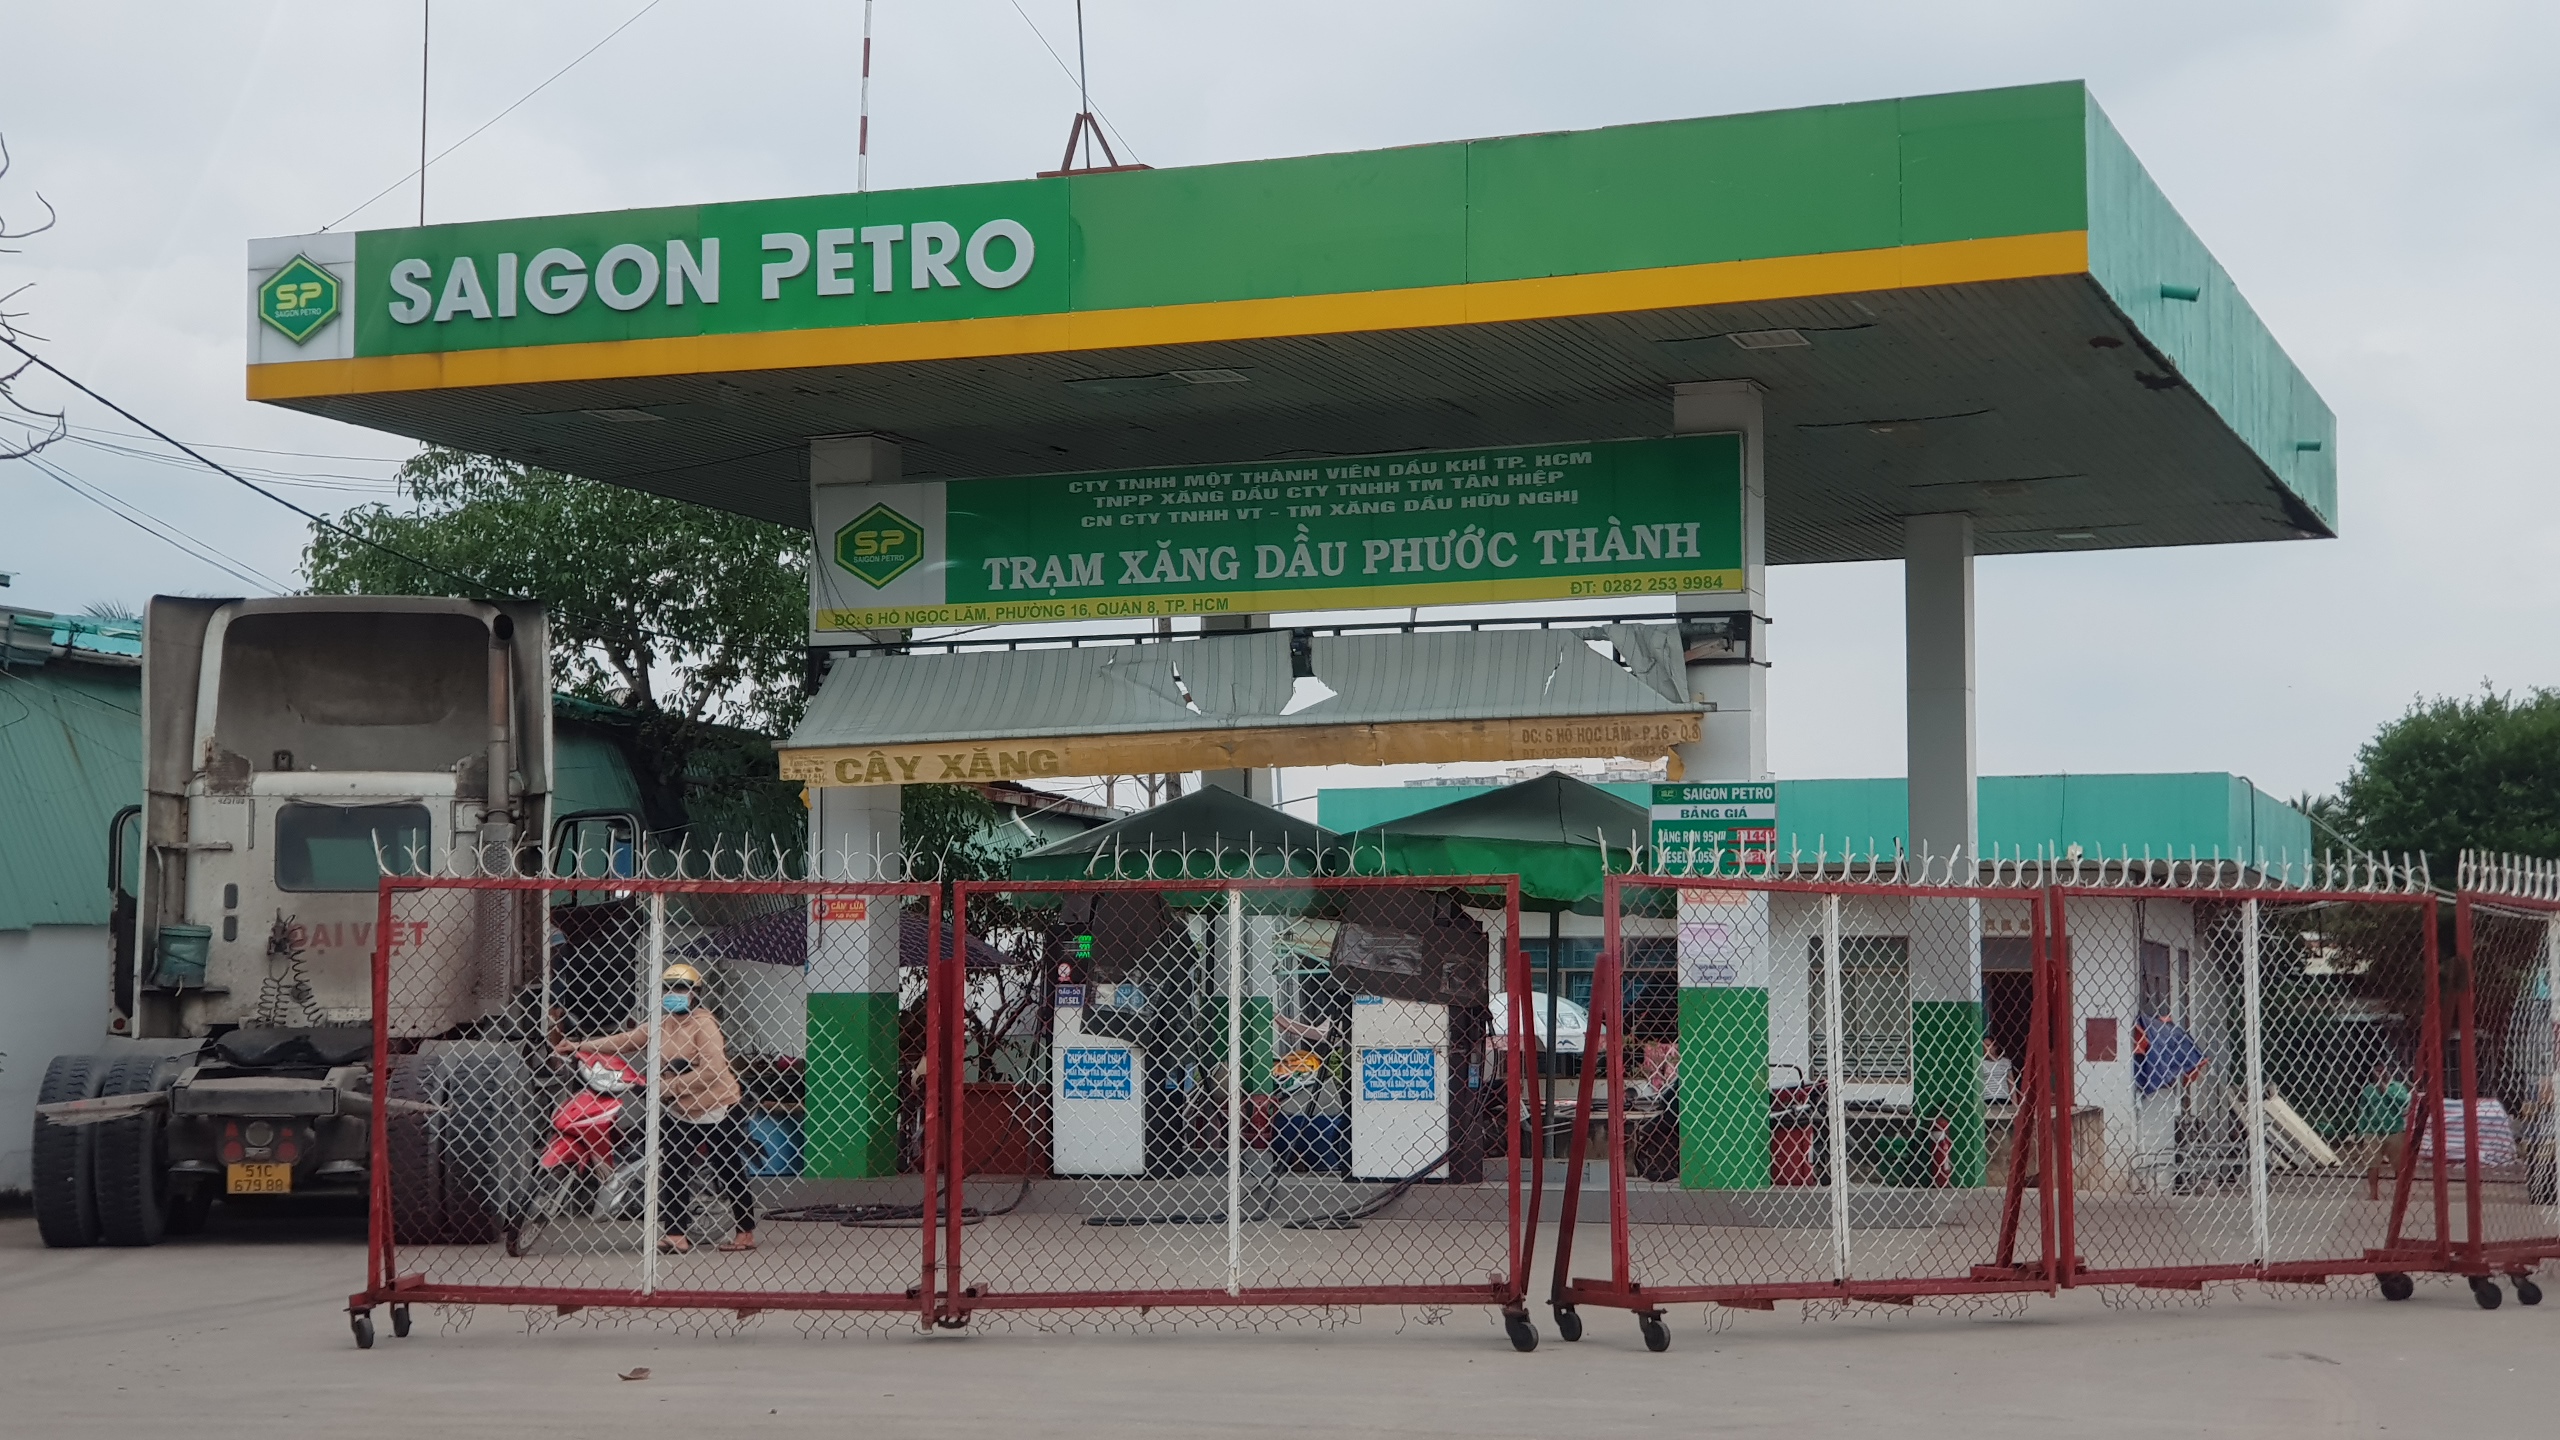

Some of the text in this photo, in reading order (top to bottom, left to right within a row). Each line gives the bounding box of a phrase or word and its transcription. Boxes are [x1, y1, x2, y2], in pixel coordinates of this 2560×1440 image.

[388, 218, 1036, 325] SAIGON PETRO
[276, 281, 322, 310] SP
[274, 307, 322, 318] SAIGON PETRO
[1069, 480, 1109, 494] CTY
[1116, 476, 1177, 491] TNHH
[1184, 472, 1234, 489] MỘT
[1240, 466, 1319, 485] THÀNH
[1325, 463, 1381, 480] VIÊN
[1446, 456, 1486, 473] KHÍ
[1494, 456, 1527, 470] TP.
[1535, 452, 1593, 467] HCM
[1093, 494, 1154, 509] TNPP
[1160, 490, 1225, 505] XĂNG
[1286, 485, 1330, 499] CTY
[1337, 481, 1400, 496] TNHH
[1407, 479, 1444, 493] TM
[1450, 475, 1500, 489] TÂN
[1508, 470, 1565, 487] HIỆP
[1081, 515, 1113, 528] CN
[1119, 512, 1161, 527] CTY
[1167, 509, 1230, 524] TNHH
[1236, 507, 1264, 521] VT
[1286, 505, 1323, 519] TM
[1329, 501, 1396, 517] XĂNG
[1461, 492, 1511, 508] HỮU
[854, 530, 905, 556] SP
[881, 554, 905, 562] PETRO
[982, 515, 1701, 596] TRẠM XĂNG DẦU PHƯỚC THÀNH
[1570, 575, 1724, 595] ĐT: 0282 253 9984
[835, 613, 861, 627] ĐC:
[865, 612, 874, 625] 6
[904, 609, 950, 626] NGỌC
[995, 601, 1066, 621] PHƯỜNG
[1070, 602, 1092, 618] 16,
[1146, 602, 1160, 616] 8,
[1164, 600, 1188, 613] TP.
[1192, 597, 1230, 612] HCM
[1545, 728, 1553, 743] 6
[1577, 727, 1602, 746] HỌC
[1642, 725, 1670, 742] P.16
[834, 750, 924, 784] CÂY
[938, 747, 1059, 780] XĂNG
[1682, 787, 1728, 801] SAIGON
[1731, 787, 1773, 800] PETRO
[1680, 806, 1748, 819] BẢNG GIÁ
[1658, 828, 1681, 843] ĂNG
[1682, 830, 1701, 843] RN
[1658, 850, 1688, 864] ESEL
[245, 1164, 273, 1178] 51C
